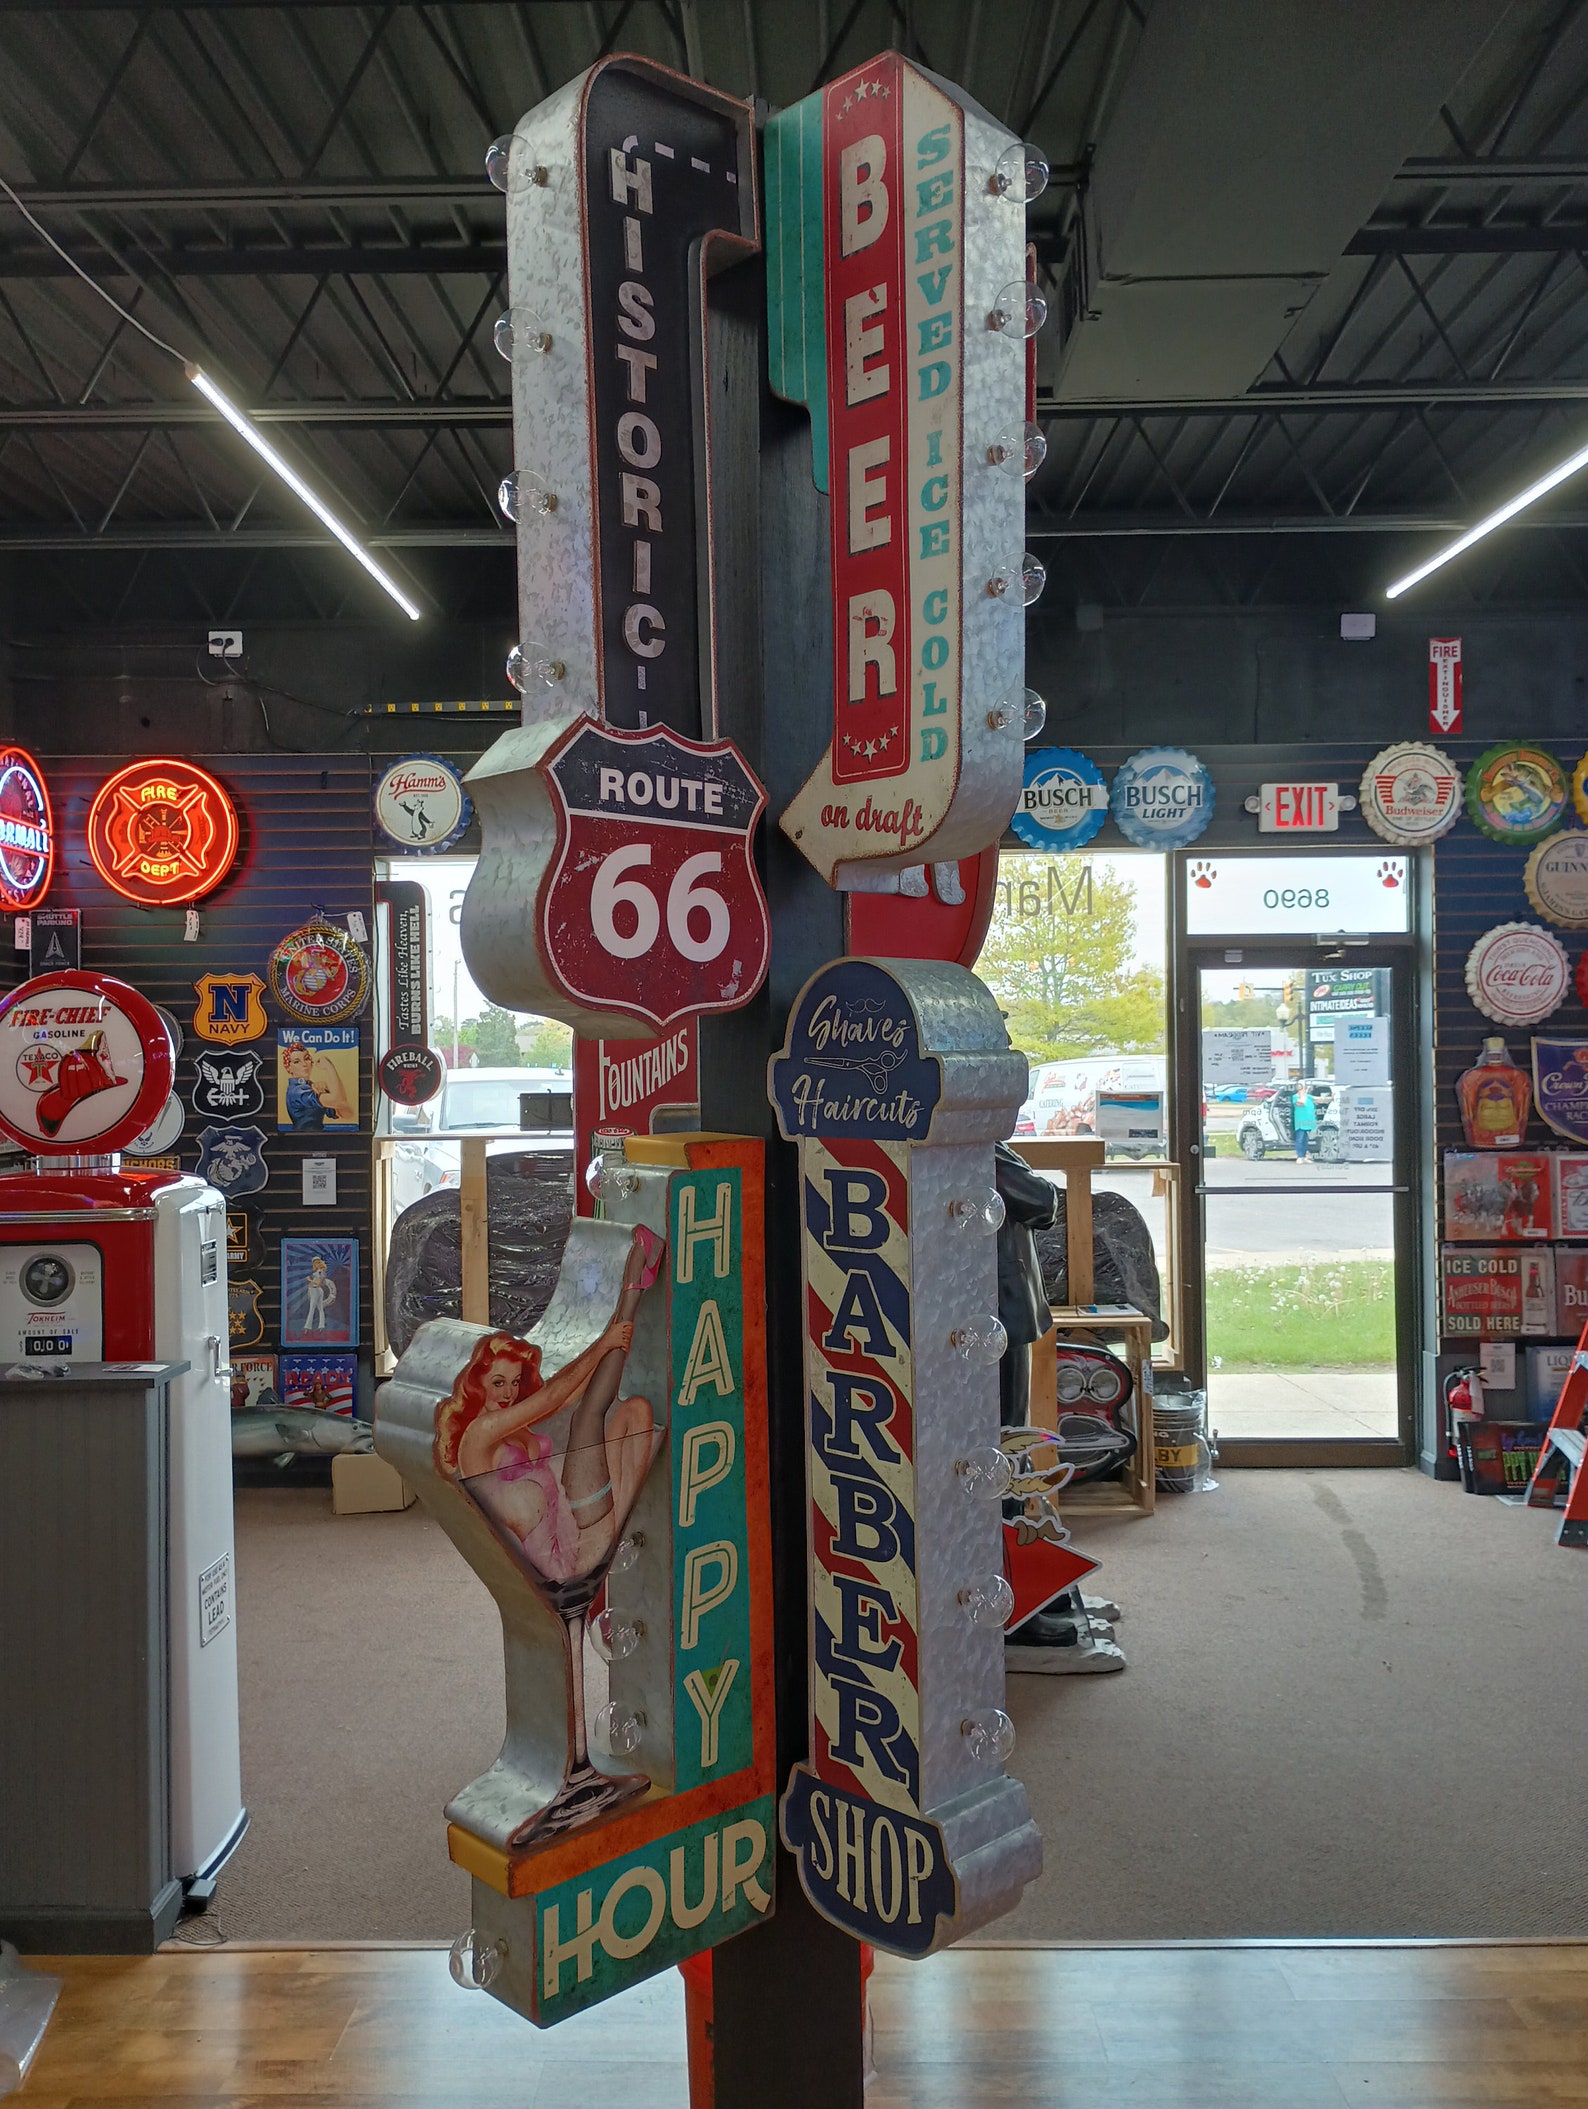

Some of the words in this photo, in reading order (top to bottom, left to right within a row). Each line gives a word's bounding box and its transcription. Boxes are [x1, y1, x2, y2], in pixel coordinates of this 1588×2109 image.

[915, 123, 954, 402] SERVED
[610, 147, 667, 658] HISTORIC
[840, 134, 898, 704] BEER
[919, 429, 950, 560] ICE
[1433, 646, 1458, 658] FIRE
[920, 589, 950, 762] COLD
[141, 785, 178, 802] FIRE
[388, 772, 446, 798] Hamm's
[599, 767, 724, 815] ROUTE
[1125, 785, 1202, 808] BUSCH
[1024, 787, 1093, 810] BUSCH
[1274, 786, 1328, 828] EXIT
[1385, 805, 1444, 816] Budweiser
[820, 803, 849, 828] on
[855, 796, 924, 846] draft
[1142, 808, 1187, 819] LIGHT
[140, 861, 180, 877] DEPT
[590, 843, 731, 963] 66
[409, 904, 421, 942] HELL
[396, 961, 409, 988] Like
[410, 945, 421, 979] LIKE
[208, 983, 253, 1023] N
[281, 986, 320, 1017] MARINE
[323, 988, 357, 1017] CORPS
[396, 991, 410, 1031] Tastes
[410, 980, 422, 1035] BURNS
[9, 1006, 112, 1028] FIRE-CHIEF
[209, 1024, 250, 1034] NAVY
[808, 996, 911, 1048] Shaves
[33, 1029, 86, 1040] GASOLINE
[282, 1031, 300, 1043] We
[301, 1031, 322, 1044] Can
[324, 1031, 341, 1043] Do
[342, 1031, 355, 1044] It!
[23, 1052, 59, 1062] TEXACO
[386, 1051, 434, 1071] FIREBALL
[599, 1028, 690, 1121] FOUNTAINS
[1541, 1072, 1584, 1096] Crown
[791, 1074, 925, 1130] Haircuts
[1446, 1259, 1471, 1274] ICE
[1478, 1259, 1518, 1274] COLD
[1564, 1284, 1588, 1306] Bu
[27, 1311, 66, 1325] TOKHEIM
[1448, 1316, 1481, 1330] SOLD
[1487, 1316, 1520, 1331] HERE
[242, 1362, 273, 1372] FORCE
[285, 1370, 352, 1386] READY
[1154, 1448, 1182, 1462] BY
[677, 1182, 740, 1768] HAPPY
[823, 1168, 910, 1789] BARBER
[208, 1600, 225, 1625] LEAD
[810, 1789, 935, 1925] SHOP
[543, 1818, 772, 2000] HOUR
